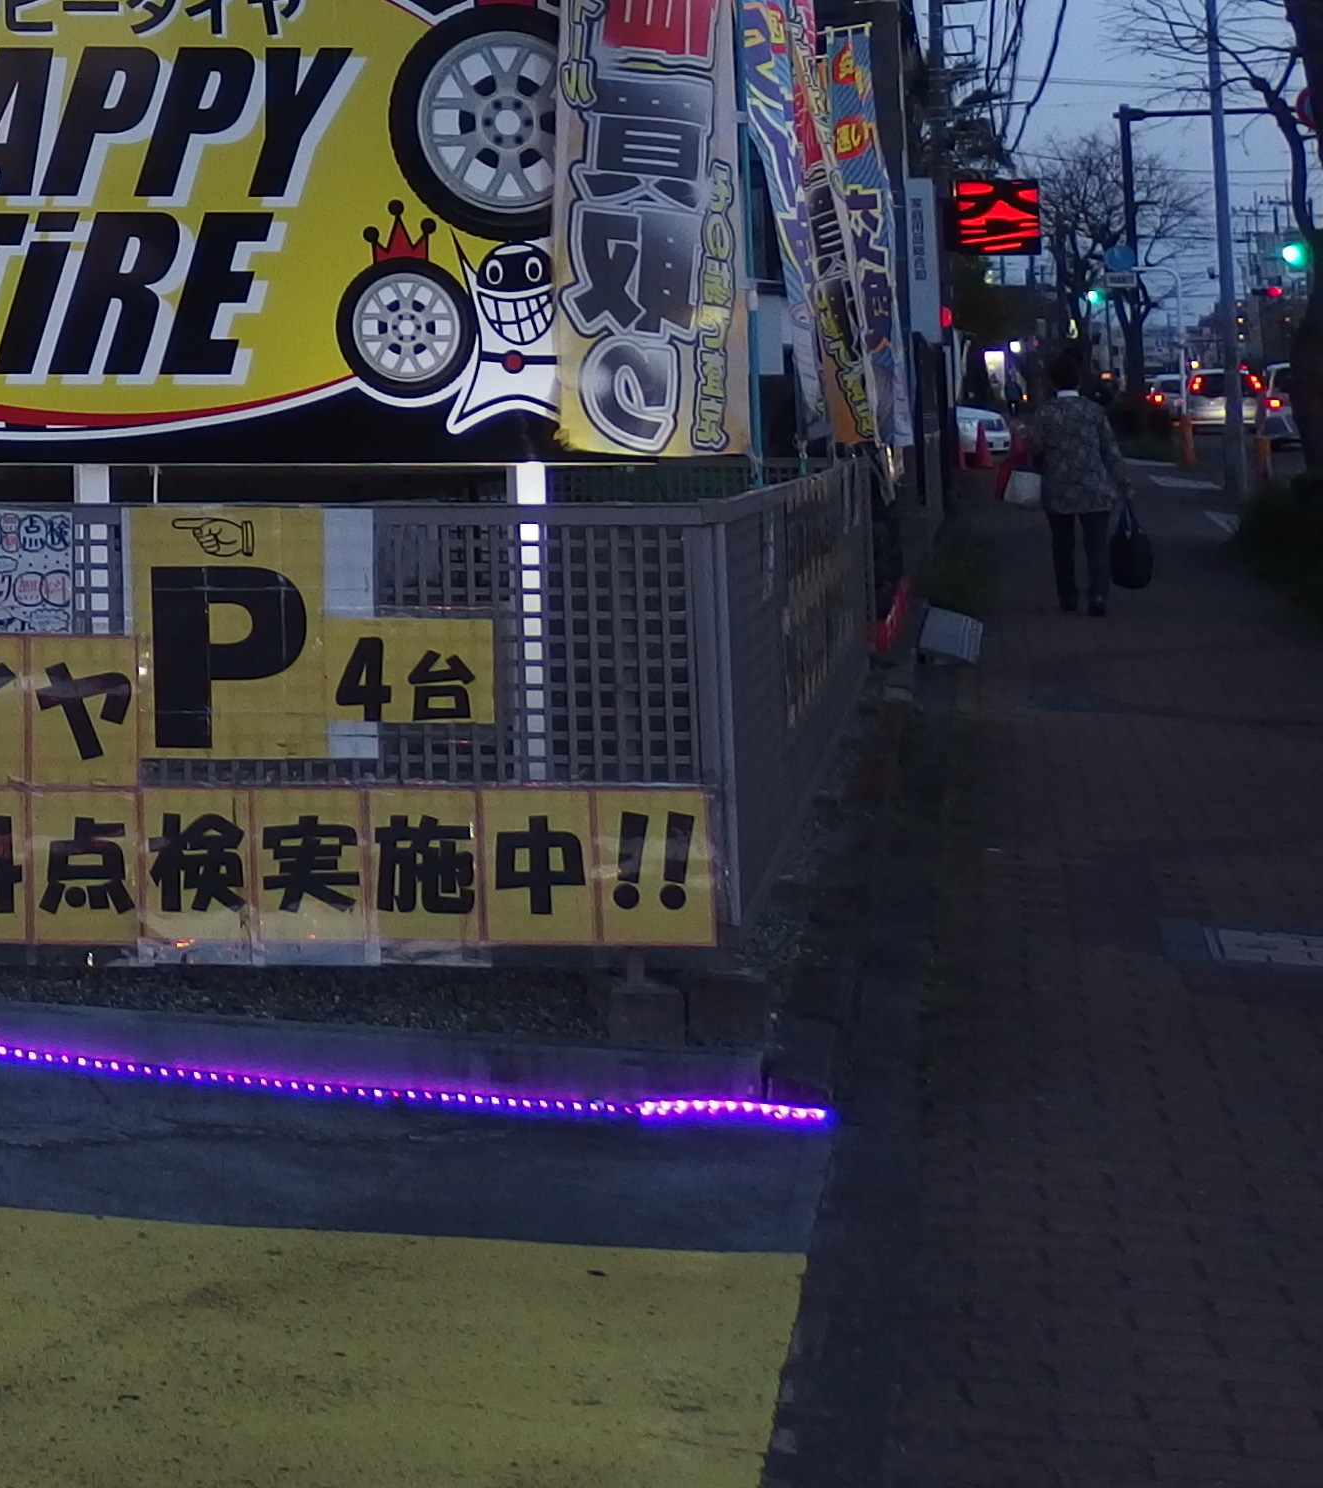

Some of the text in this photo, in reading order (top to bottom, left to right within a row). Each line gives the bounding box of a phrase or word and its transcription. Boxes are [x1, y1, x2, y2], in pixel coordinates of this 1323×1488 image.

[21, 516, 71, 549] 点検
[152, 566, 308, 750] P
[335, 636, 474, 724] 4台
